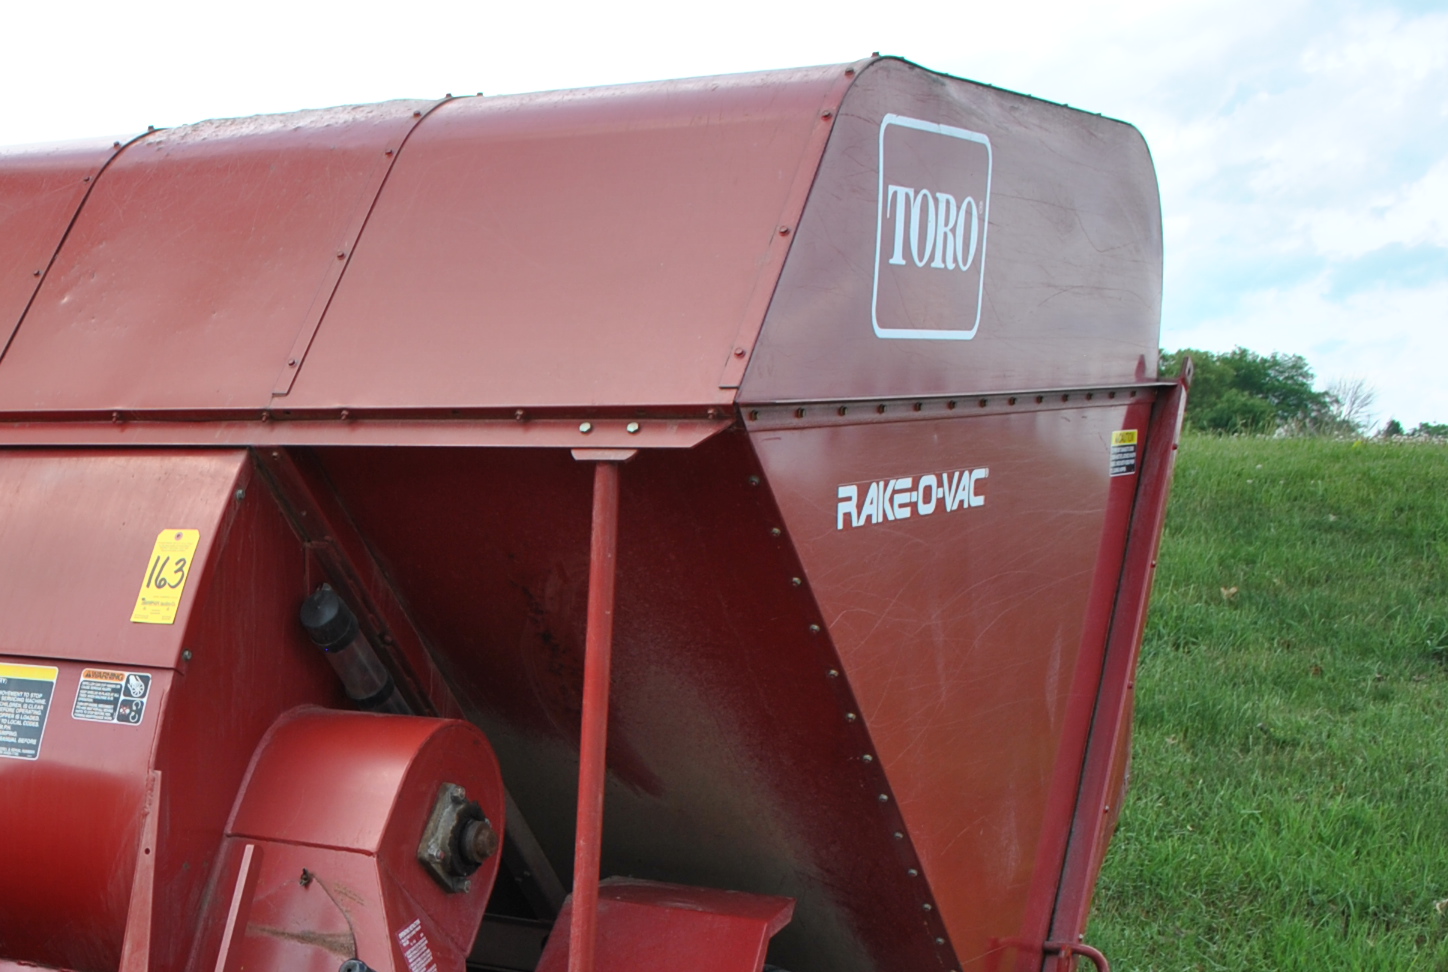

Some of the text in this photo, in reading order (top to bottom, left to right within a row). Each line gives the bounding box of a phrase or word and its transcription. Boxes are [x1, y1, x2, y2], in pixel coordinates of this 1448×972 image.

[887, 185, 979, 271] TORO
[837, 467, 989, 530] RAKE-O-VAC
[146, 555, 187, 589] 163
